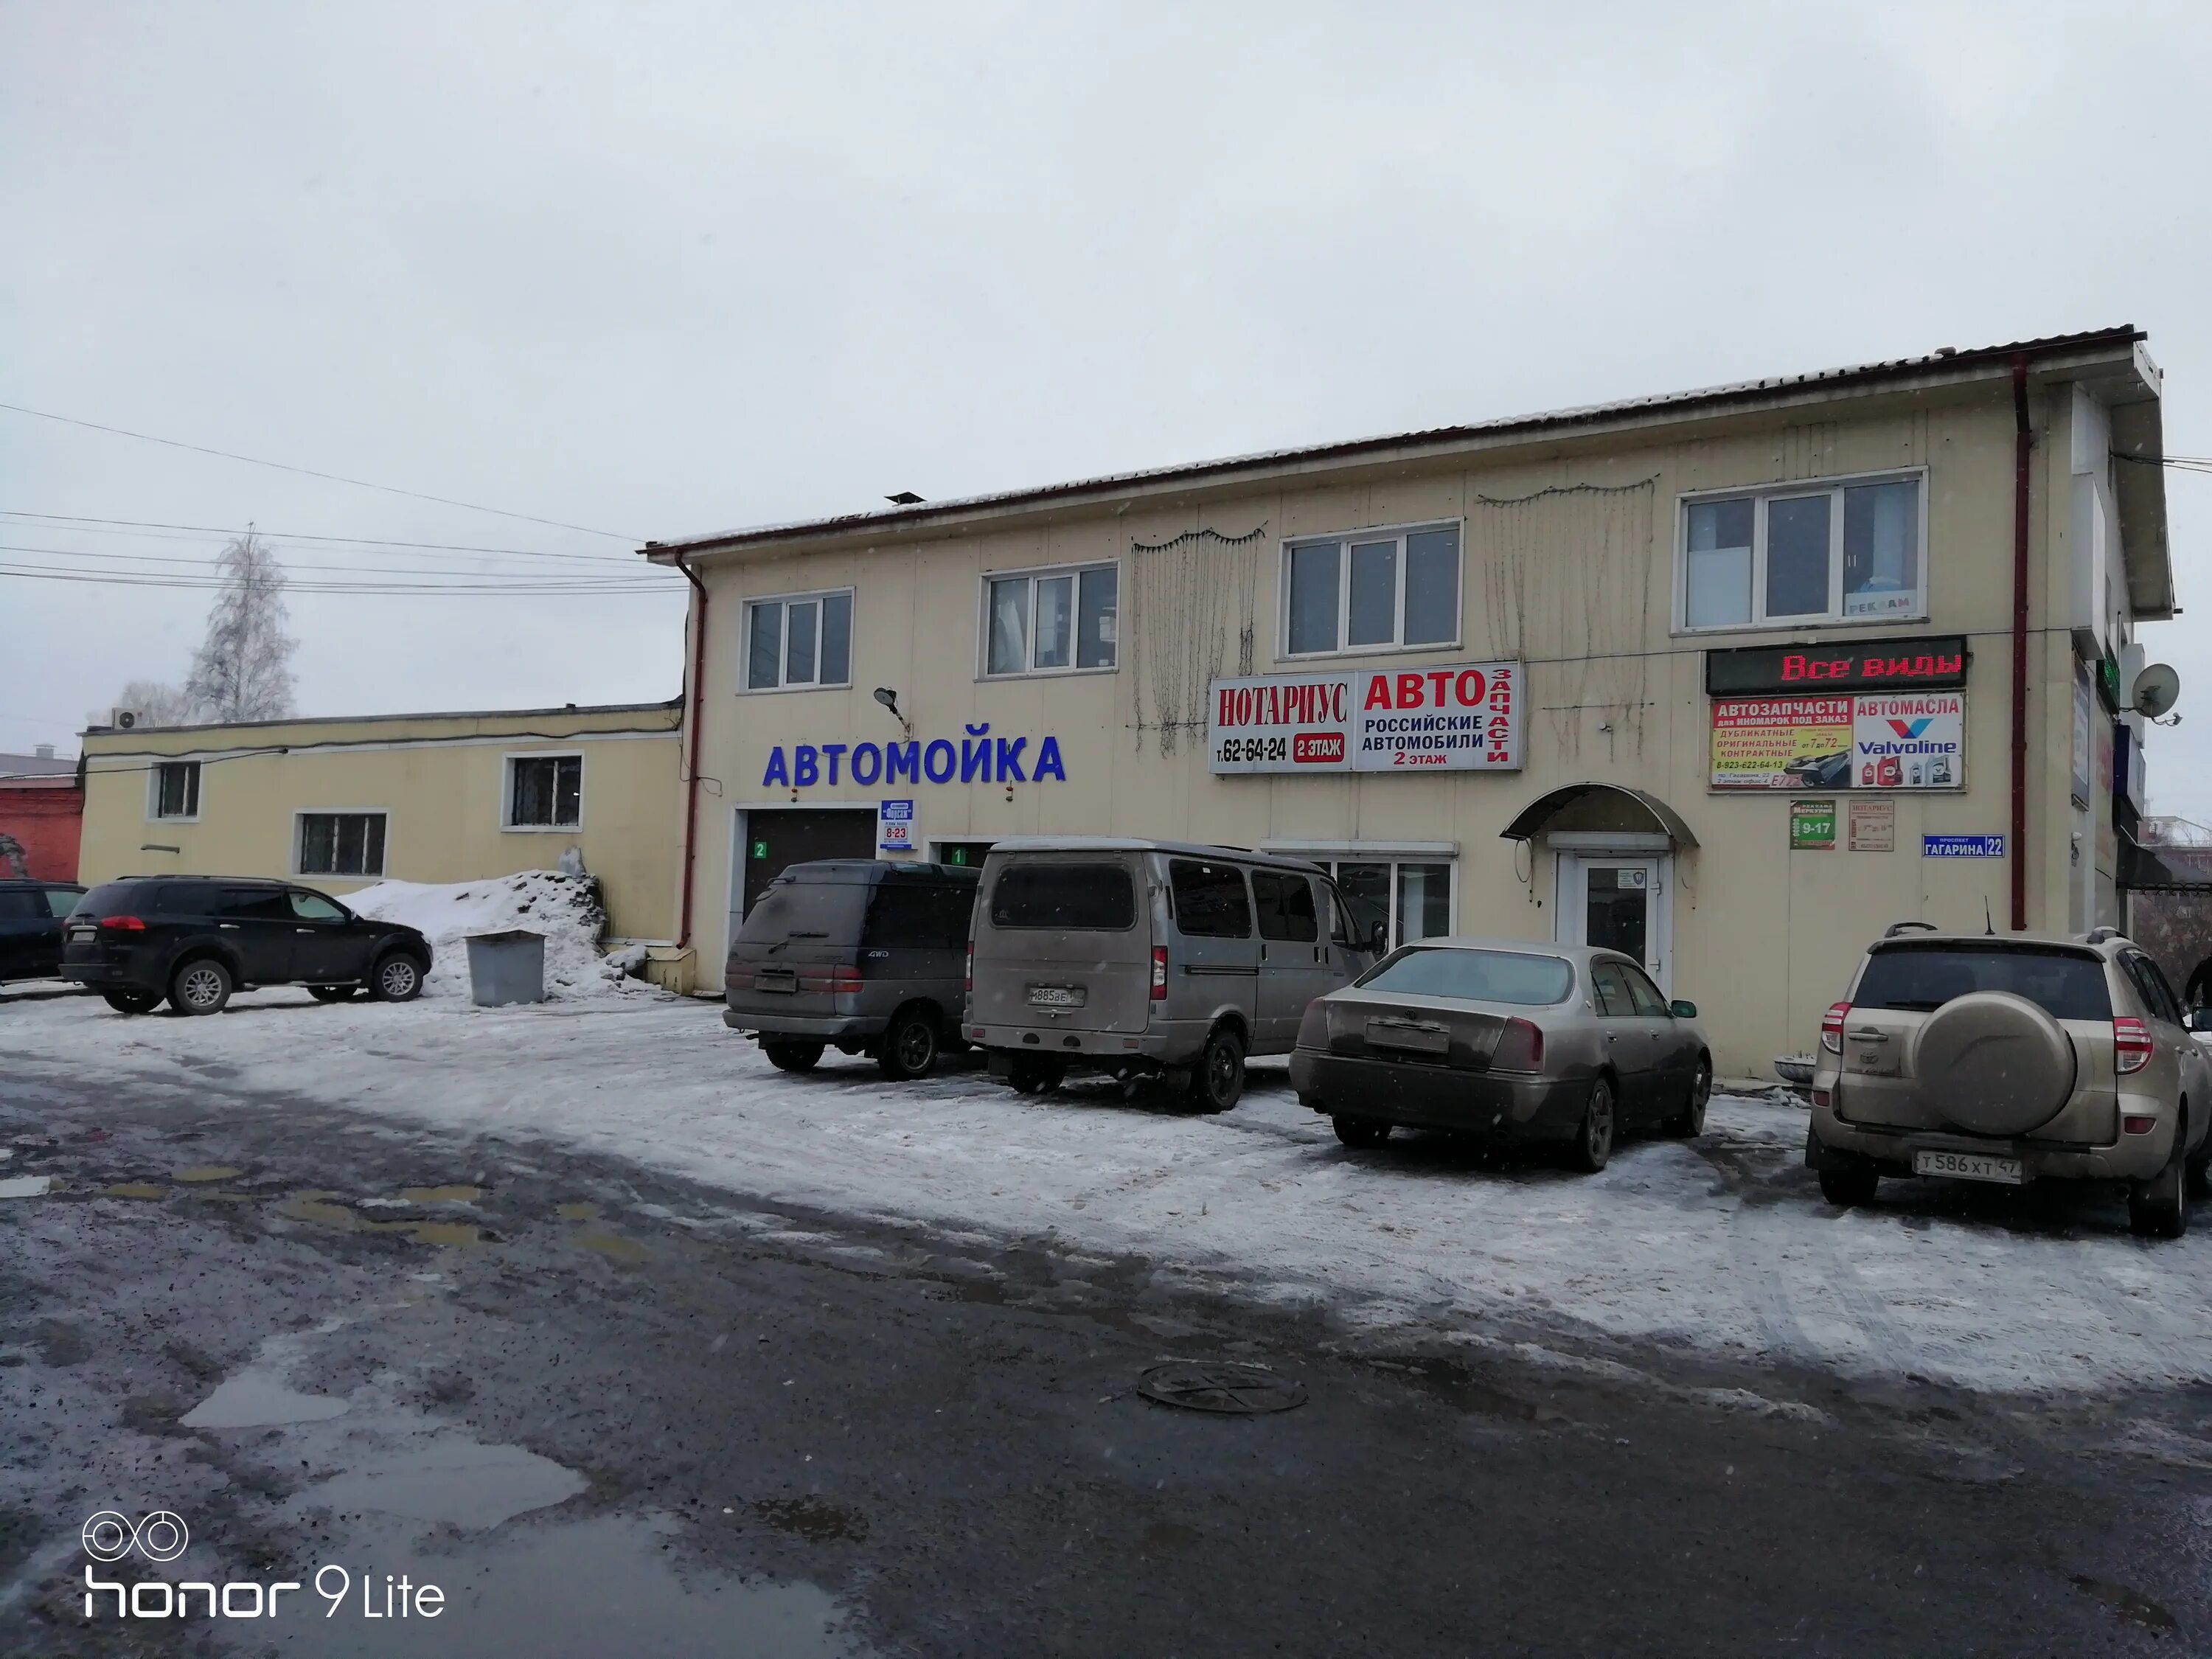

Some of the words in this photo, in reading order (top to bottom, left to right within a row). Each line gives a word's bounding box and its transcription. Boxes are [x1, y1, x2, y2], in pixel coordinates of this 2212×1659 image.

[1781, 655, 1851, 681] Все
[1861, 654, 1961, 678] виды
[1364, 669, 1486, 710] АВТО
[1218, 681, 1348, 726] НОТАРИУС
[1717, 700, 1848, 717] АВТОЗАПЧАСТИ
[1857, 698, 1959, 716] АВТОМАСЛА
[1366, 714, 1483, 733] РОССИЙСКИЕ
[1486, 669, 1512, 762] ЗАПЧАСТИ
[1736, 717, 1790, 726] ИНОМАРОК
[1792, 716, 1812, 725] ПОД
[1815, 715, 1848, 723] ЗАКАЗ
[1720, 728, 1795, 738] ДУБЛИКАТНЫЕ
[1297, 740, 1305, 757] 2
[1307, 739, 1342, 756] ЭТАЖ
[1362, 734, 1484, 751] АВТОМОБИЛИ
[1717, 740, 1798, 748] ОРИГИНАЛЬНЫЕ
[1811, 738, 1817, 748] 7
[1825, 738, 1837, 748] 72
[1858, 740, 1957, 755] Valvoline
[762, 723, 1066, 786] АВТОМОЙКА
[1394, 752, 1405, 765] 2
[1409, 753, 1447, 765] ЭТАЖ
[1720, 749, 1793, 757] КОНТРАКТНЫЕ
[886, 827, 905, 838] 8-23
[1803, 823, 1831, 833] 9-17
[757, 844, 764, 857] 2
[1925, 844, 1983, 855] ГАГАРИНА
[1988, 838, 2002, 855] 22
[955, 849, 961, 863] 1
